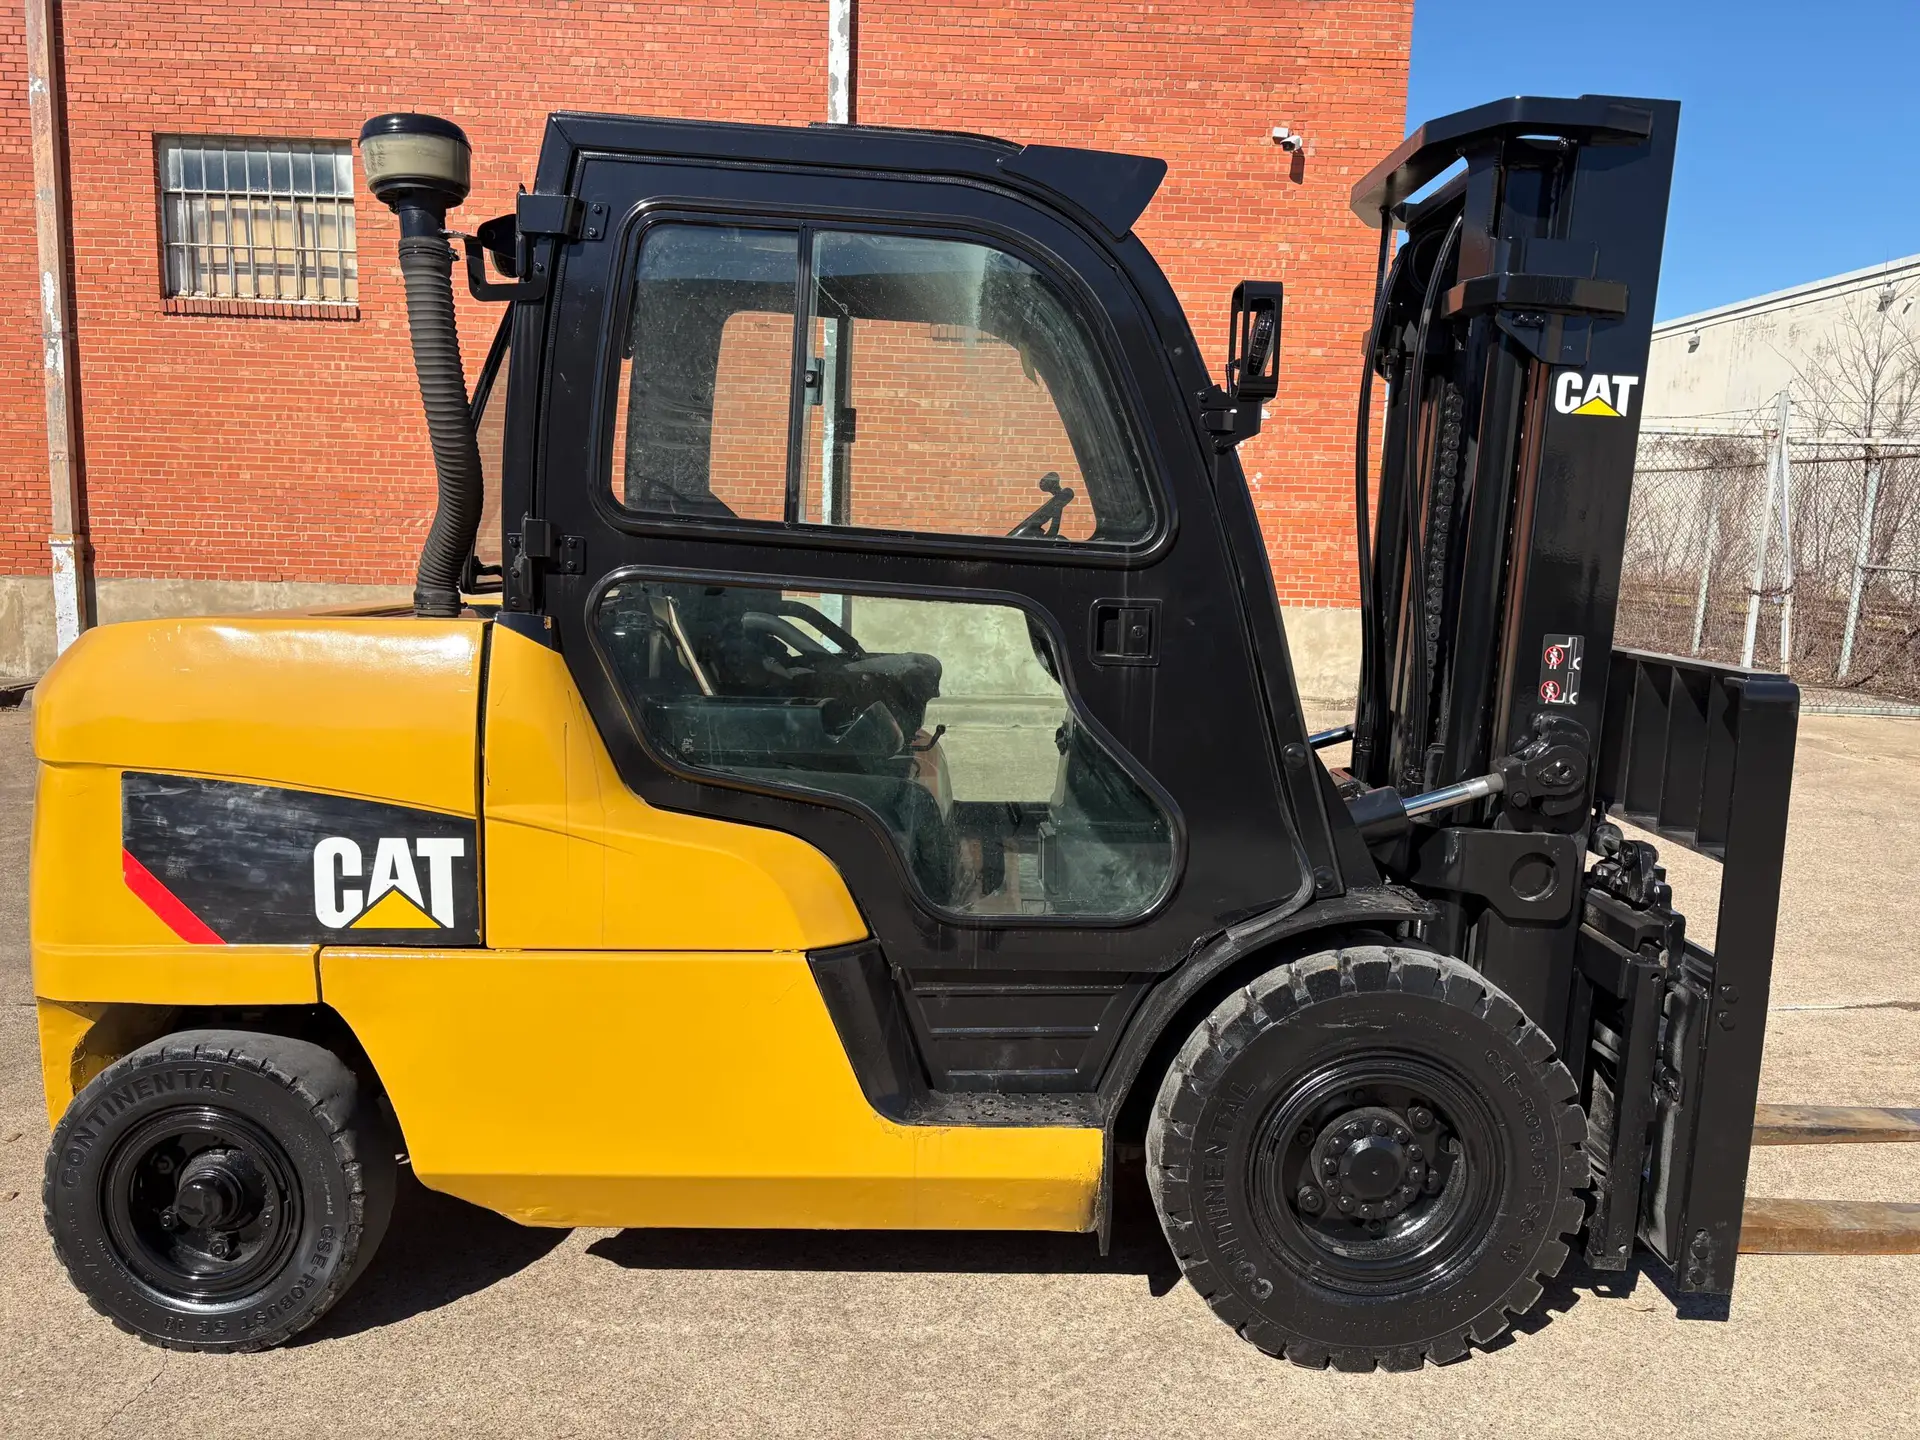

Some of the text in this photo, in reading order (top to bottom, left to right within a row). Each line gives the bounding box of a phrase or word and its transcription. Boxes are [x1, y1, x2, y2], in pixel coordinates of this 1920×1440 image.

[1554, 371, 1639, 417] CAT
[313, 836, 465, 929] CAT
[63, 1068, 238, 1190] CONTINENTAL
[1484, 1049, 1549, 1197] CSE-ROBUST
[1202, 1080, 1275, 1301] CONTINENTAL
[240, 1224, 338, 1332] CSE-ROBUST
